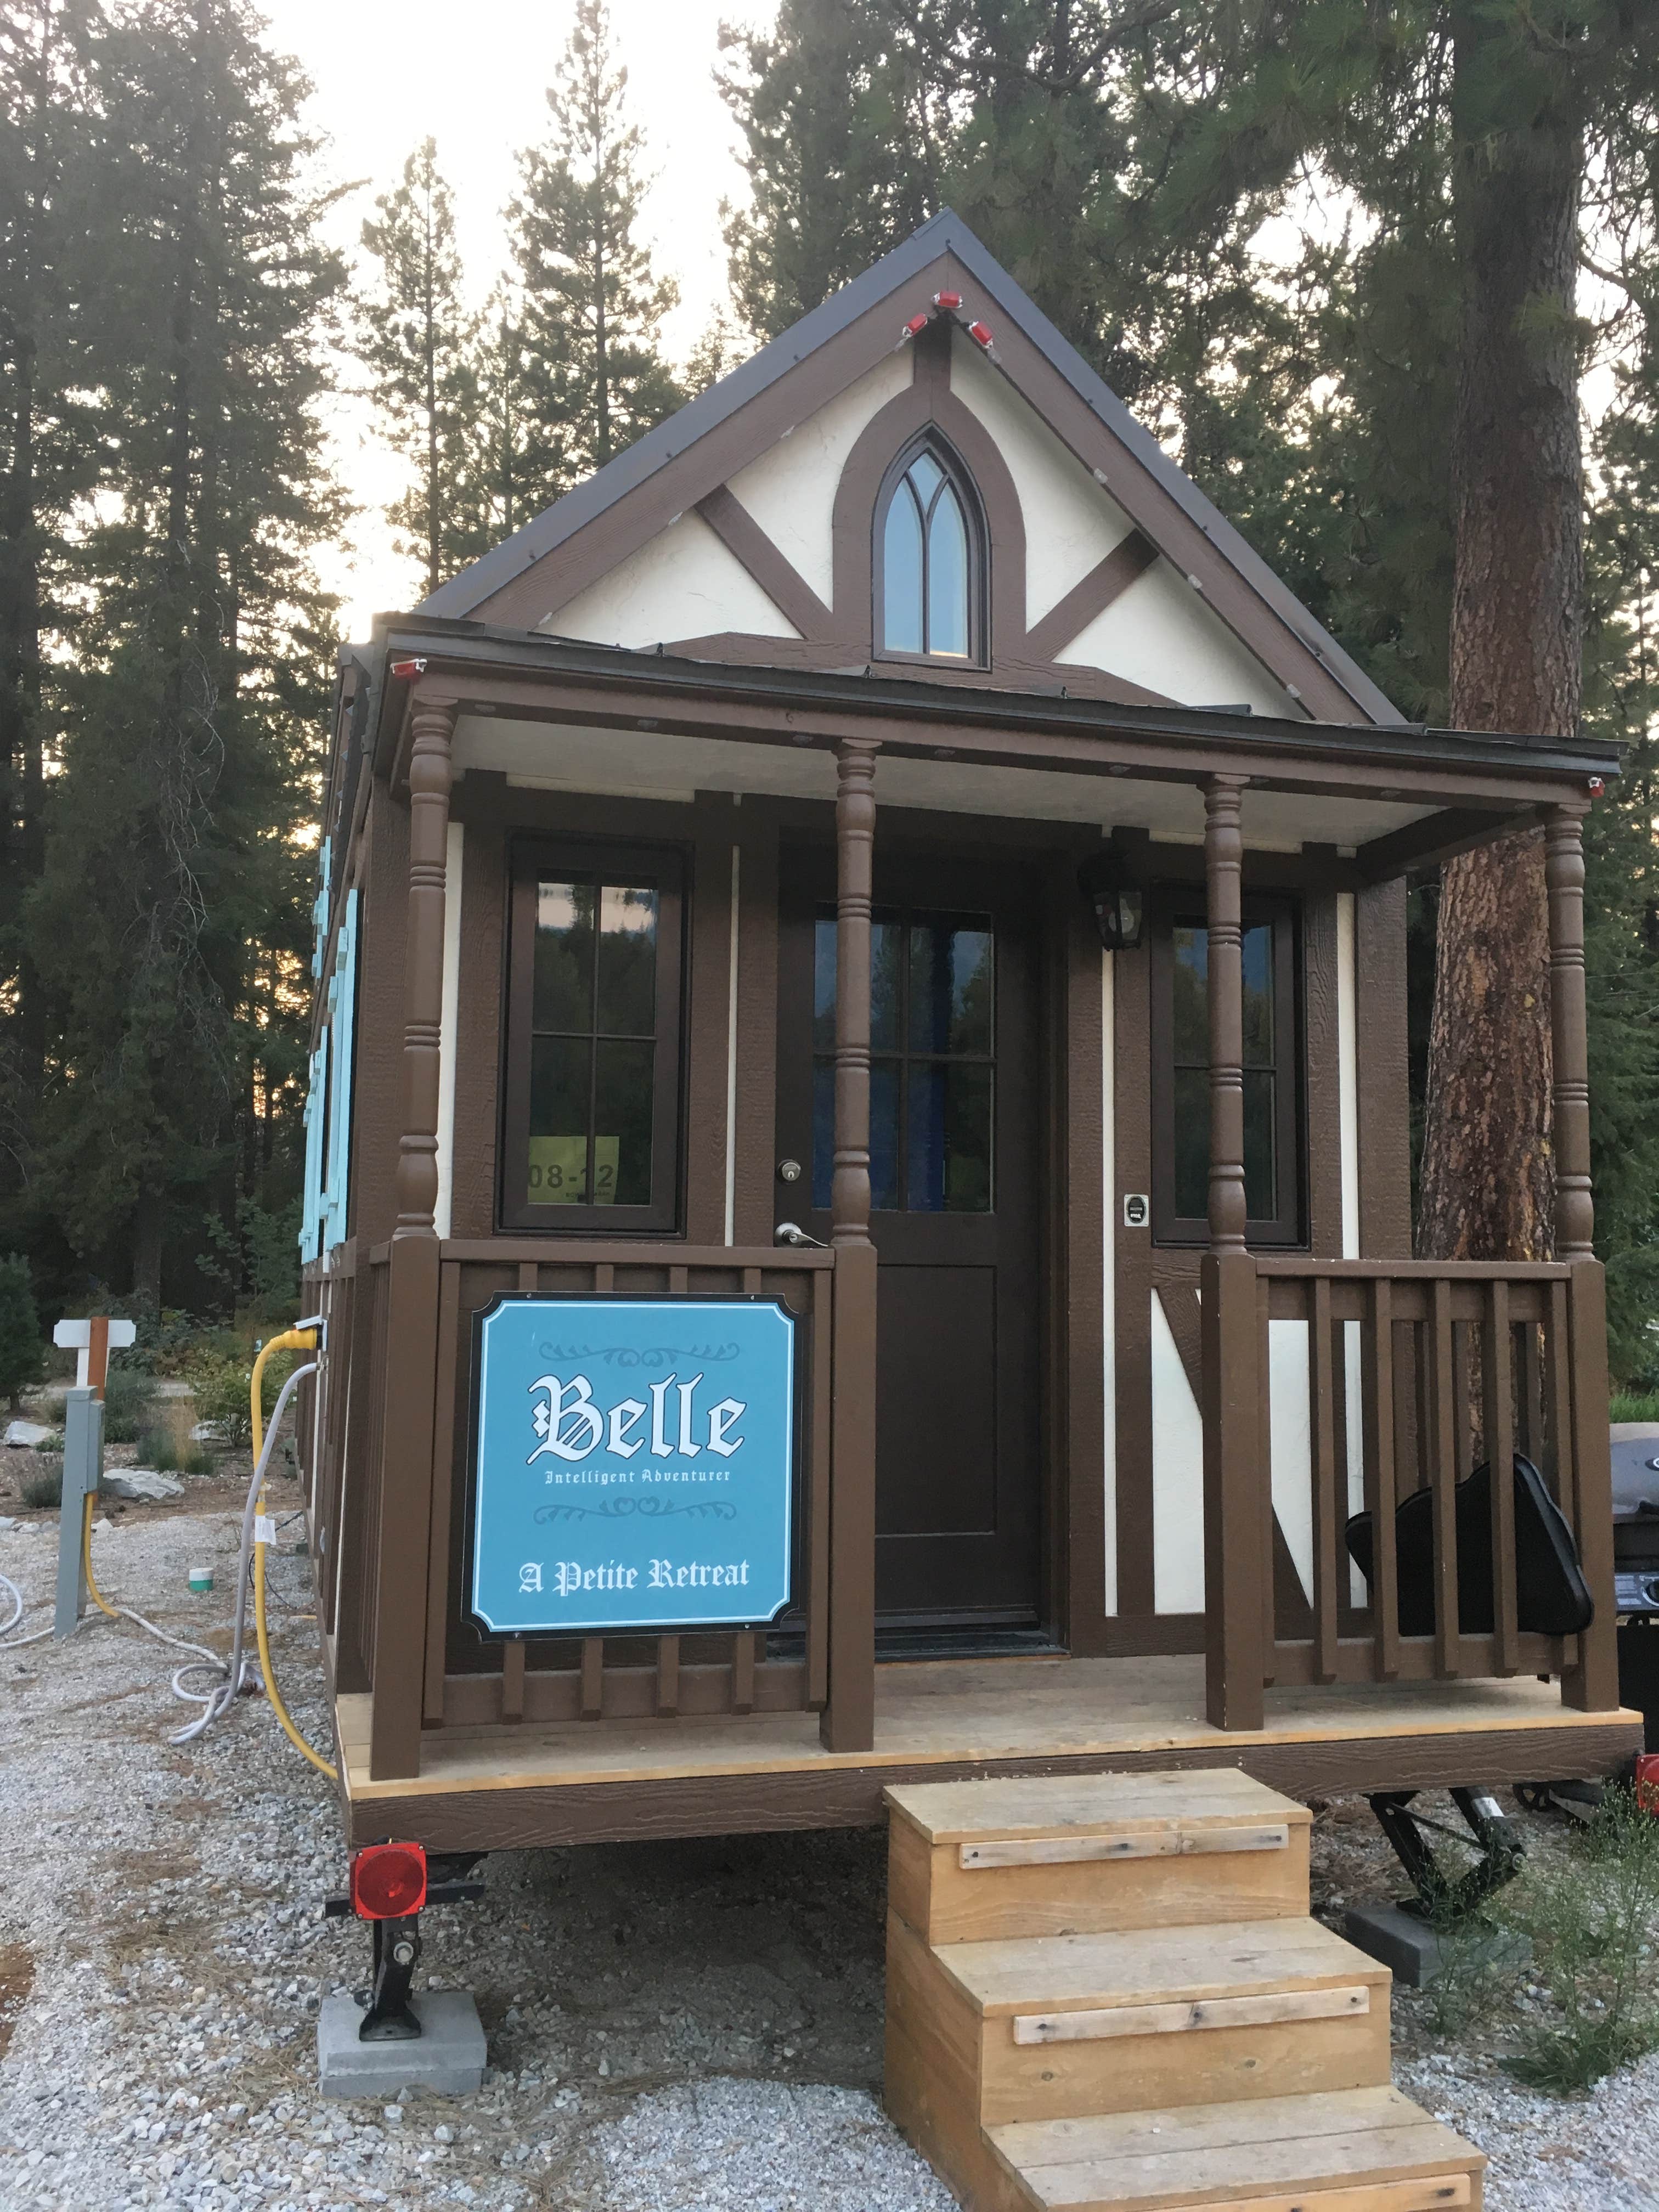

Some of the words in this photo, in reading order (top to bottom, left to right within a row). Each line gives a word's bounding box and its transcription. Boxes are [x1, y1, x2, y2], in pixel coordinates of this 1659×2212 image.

[528, 1164, 614, 1188] 08-2
[526, 1372, 747, 1465] Belle
[544, 1470, 635, 1486] Intelligent
[641, 1469, 731, 1483] Adventurer
[518, 1562, 545, 1593] A
[552, 1559, 639, 1597] Petite
[646, 1559, 750, 1589] Retreat
